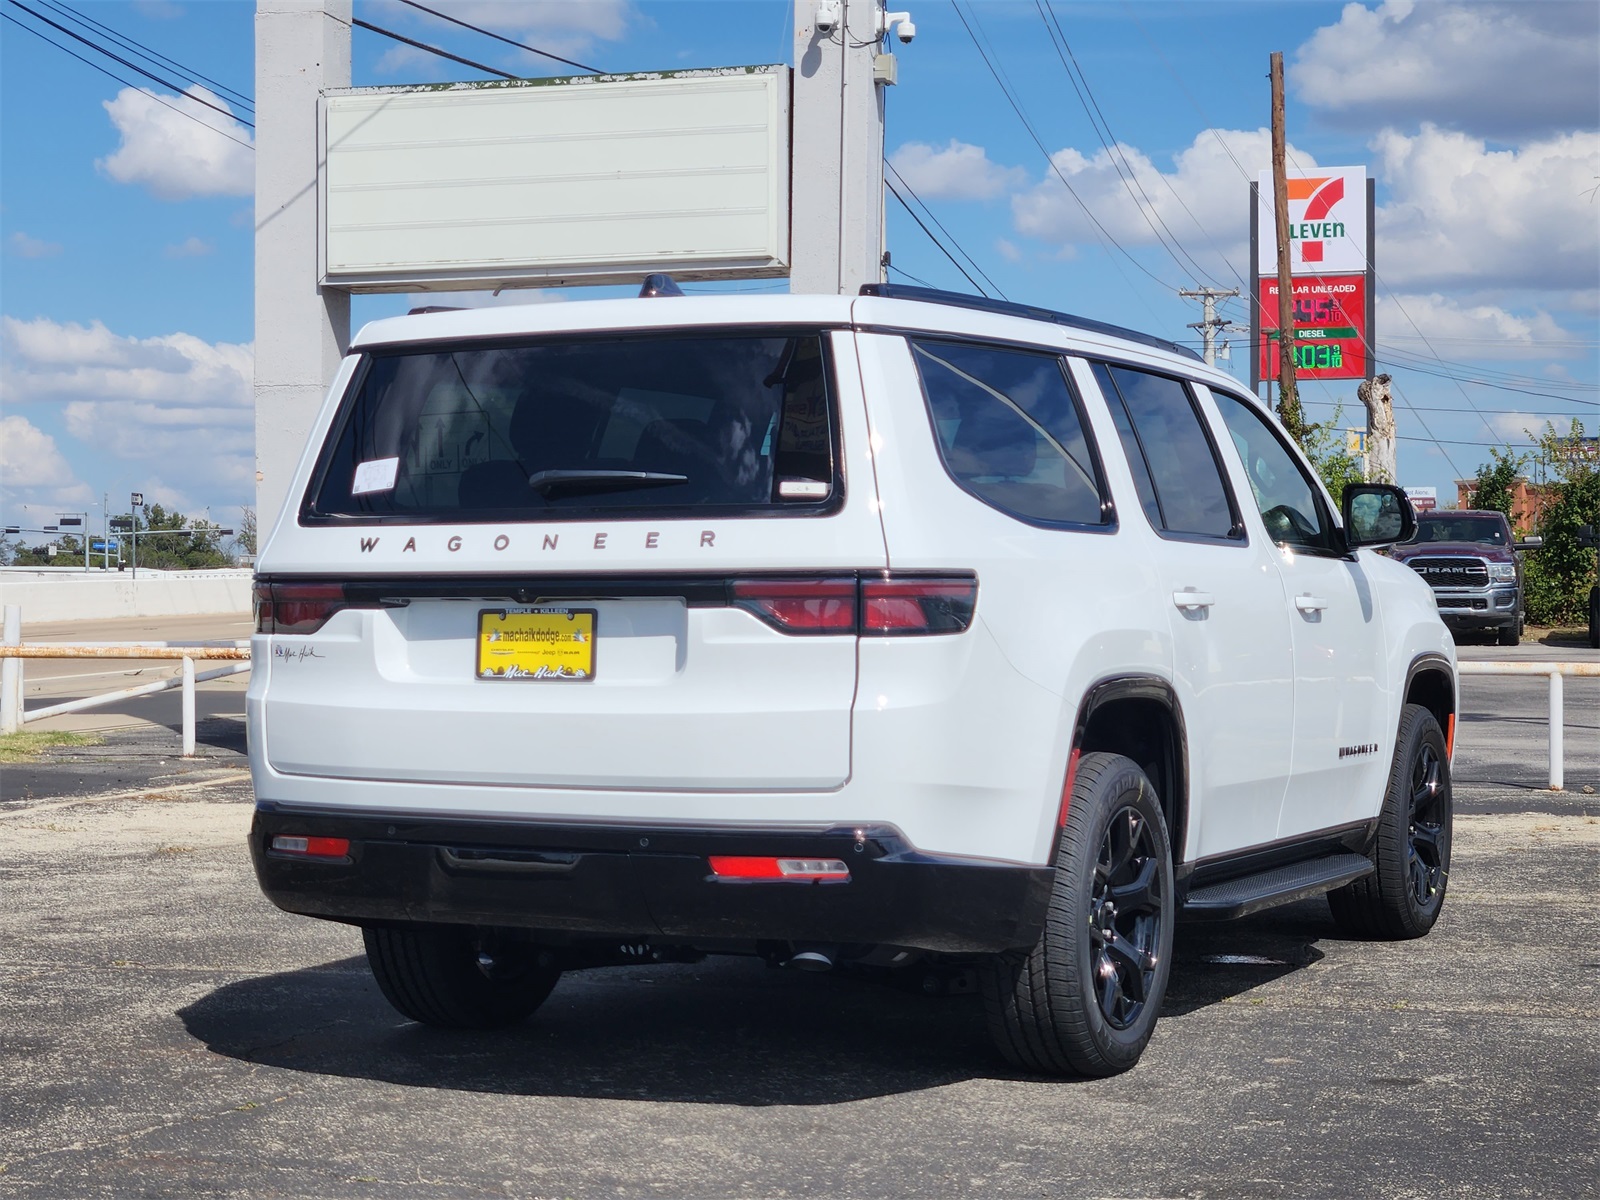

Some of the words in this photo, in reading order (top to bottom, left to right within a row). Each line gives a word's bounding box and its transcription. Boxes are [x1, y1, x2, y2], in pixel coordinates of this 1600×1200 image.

[1289, 222, 1345, 239] LEVEn
[1269, 285, 1309, 295] RELAR
[1311, 284, 1356, 294] UNLEADED
[1298, 329, 1327, 338] DIESEL
[430, 459, 452, 470] ONLY
[360, 530, 716, 553] WAGONEER
[1428, 566, 1464, 574] RAM
[502, 628, 572, 645] machaikdodge.com
[503, 664, 530, 678] Mac
[533, 665, 566, 678] Haik
